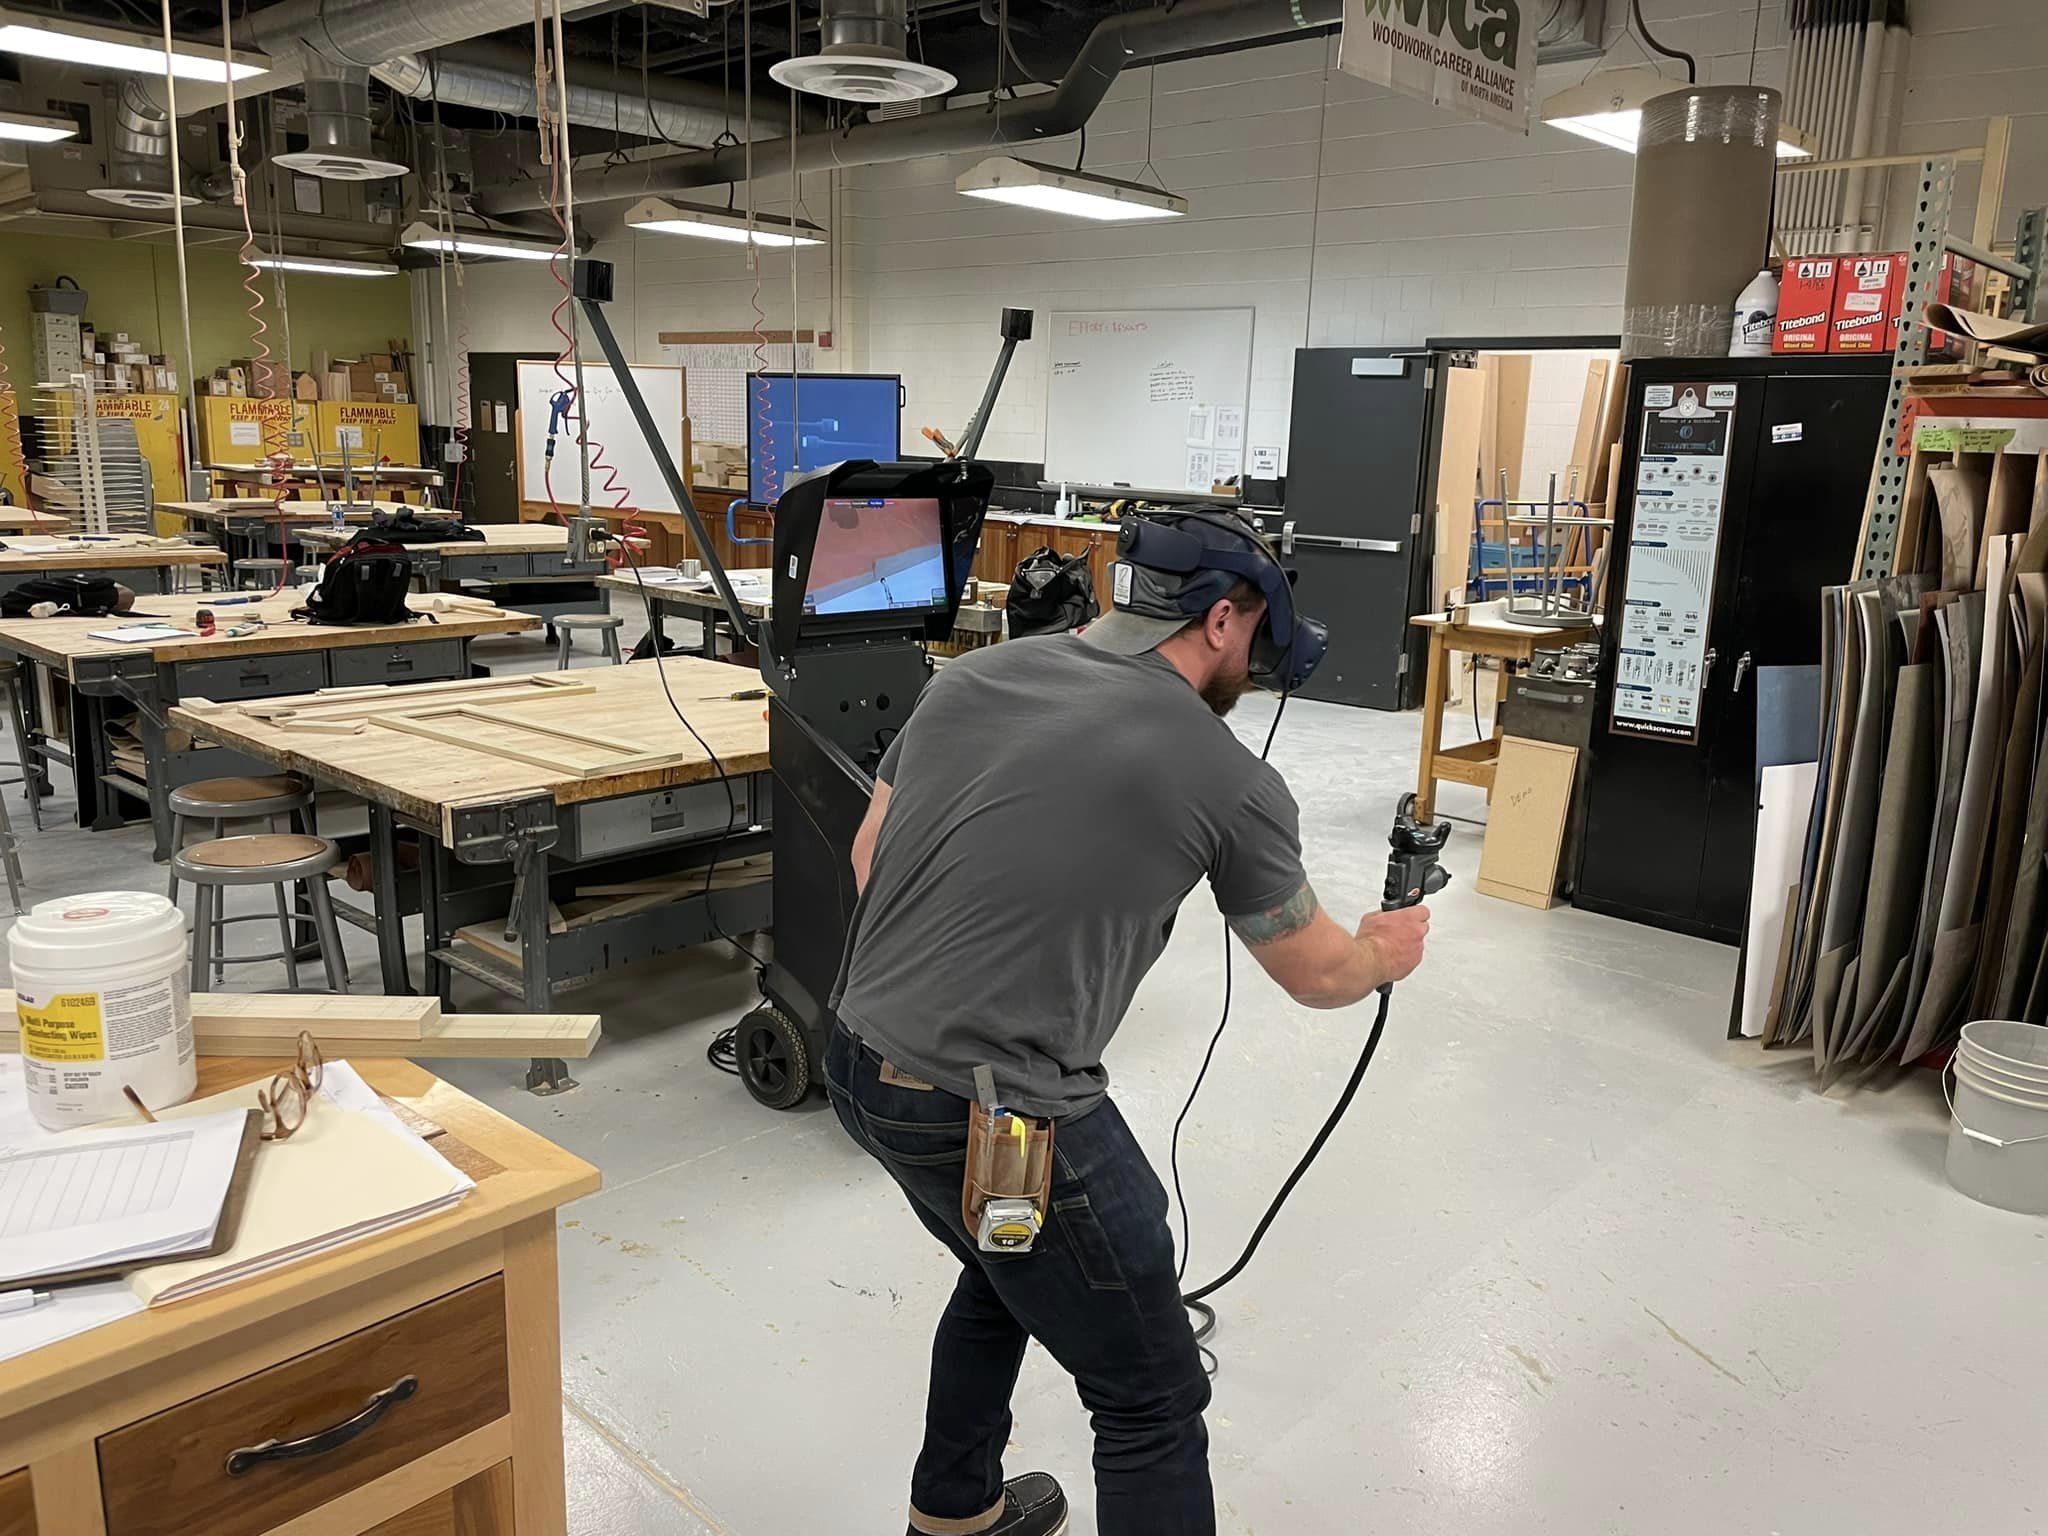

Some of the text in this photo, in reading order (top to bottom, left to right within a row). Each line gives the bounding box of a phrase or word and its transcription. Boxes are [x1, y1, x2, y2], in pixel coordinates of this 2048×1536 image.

[1372, 20, 1515, 96] WOODWORK CAREER ALLIANCE
[1469, 83, 1489, 101] NORTH
[1490, 91, 1513, 112] AMERICA
[1743, 319, 1776, 334] Titebo
[1780, 311, 1825, 331] Titebond
[1835, 311, 1882, 331] Titebond
[1783, 333, 1815, 342] ORIGINAL
[1839, 333, 1872, 342] ORIGINAL
[83, 400, 152, 411] FAMMABLE
[230, 403, 291, 415] FLAMMABLE
[340, 407, 396, 419] FLAMMABLE
[1616, 720, 1691, 736] www.quickscrews.com
[43, 1019, 75, 1029] Purpose
[69, 1031, 97, 1040] Wipes
